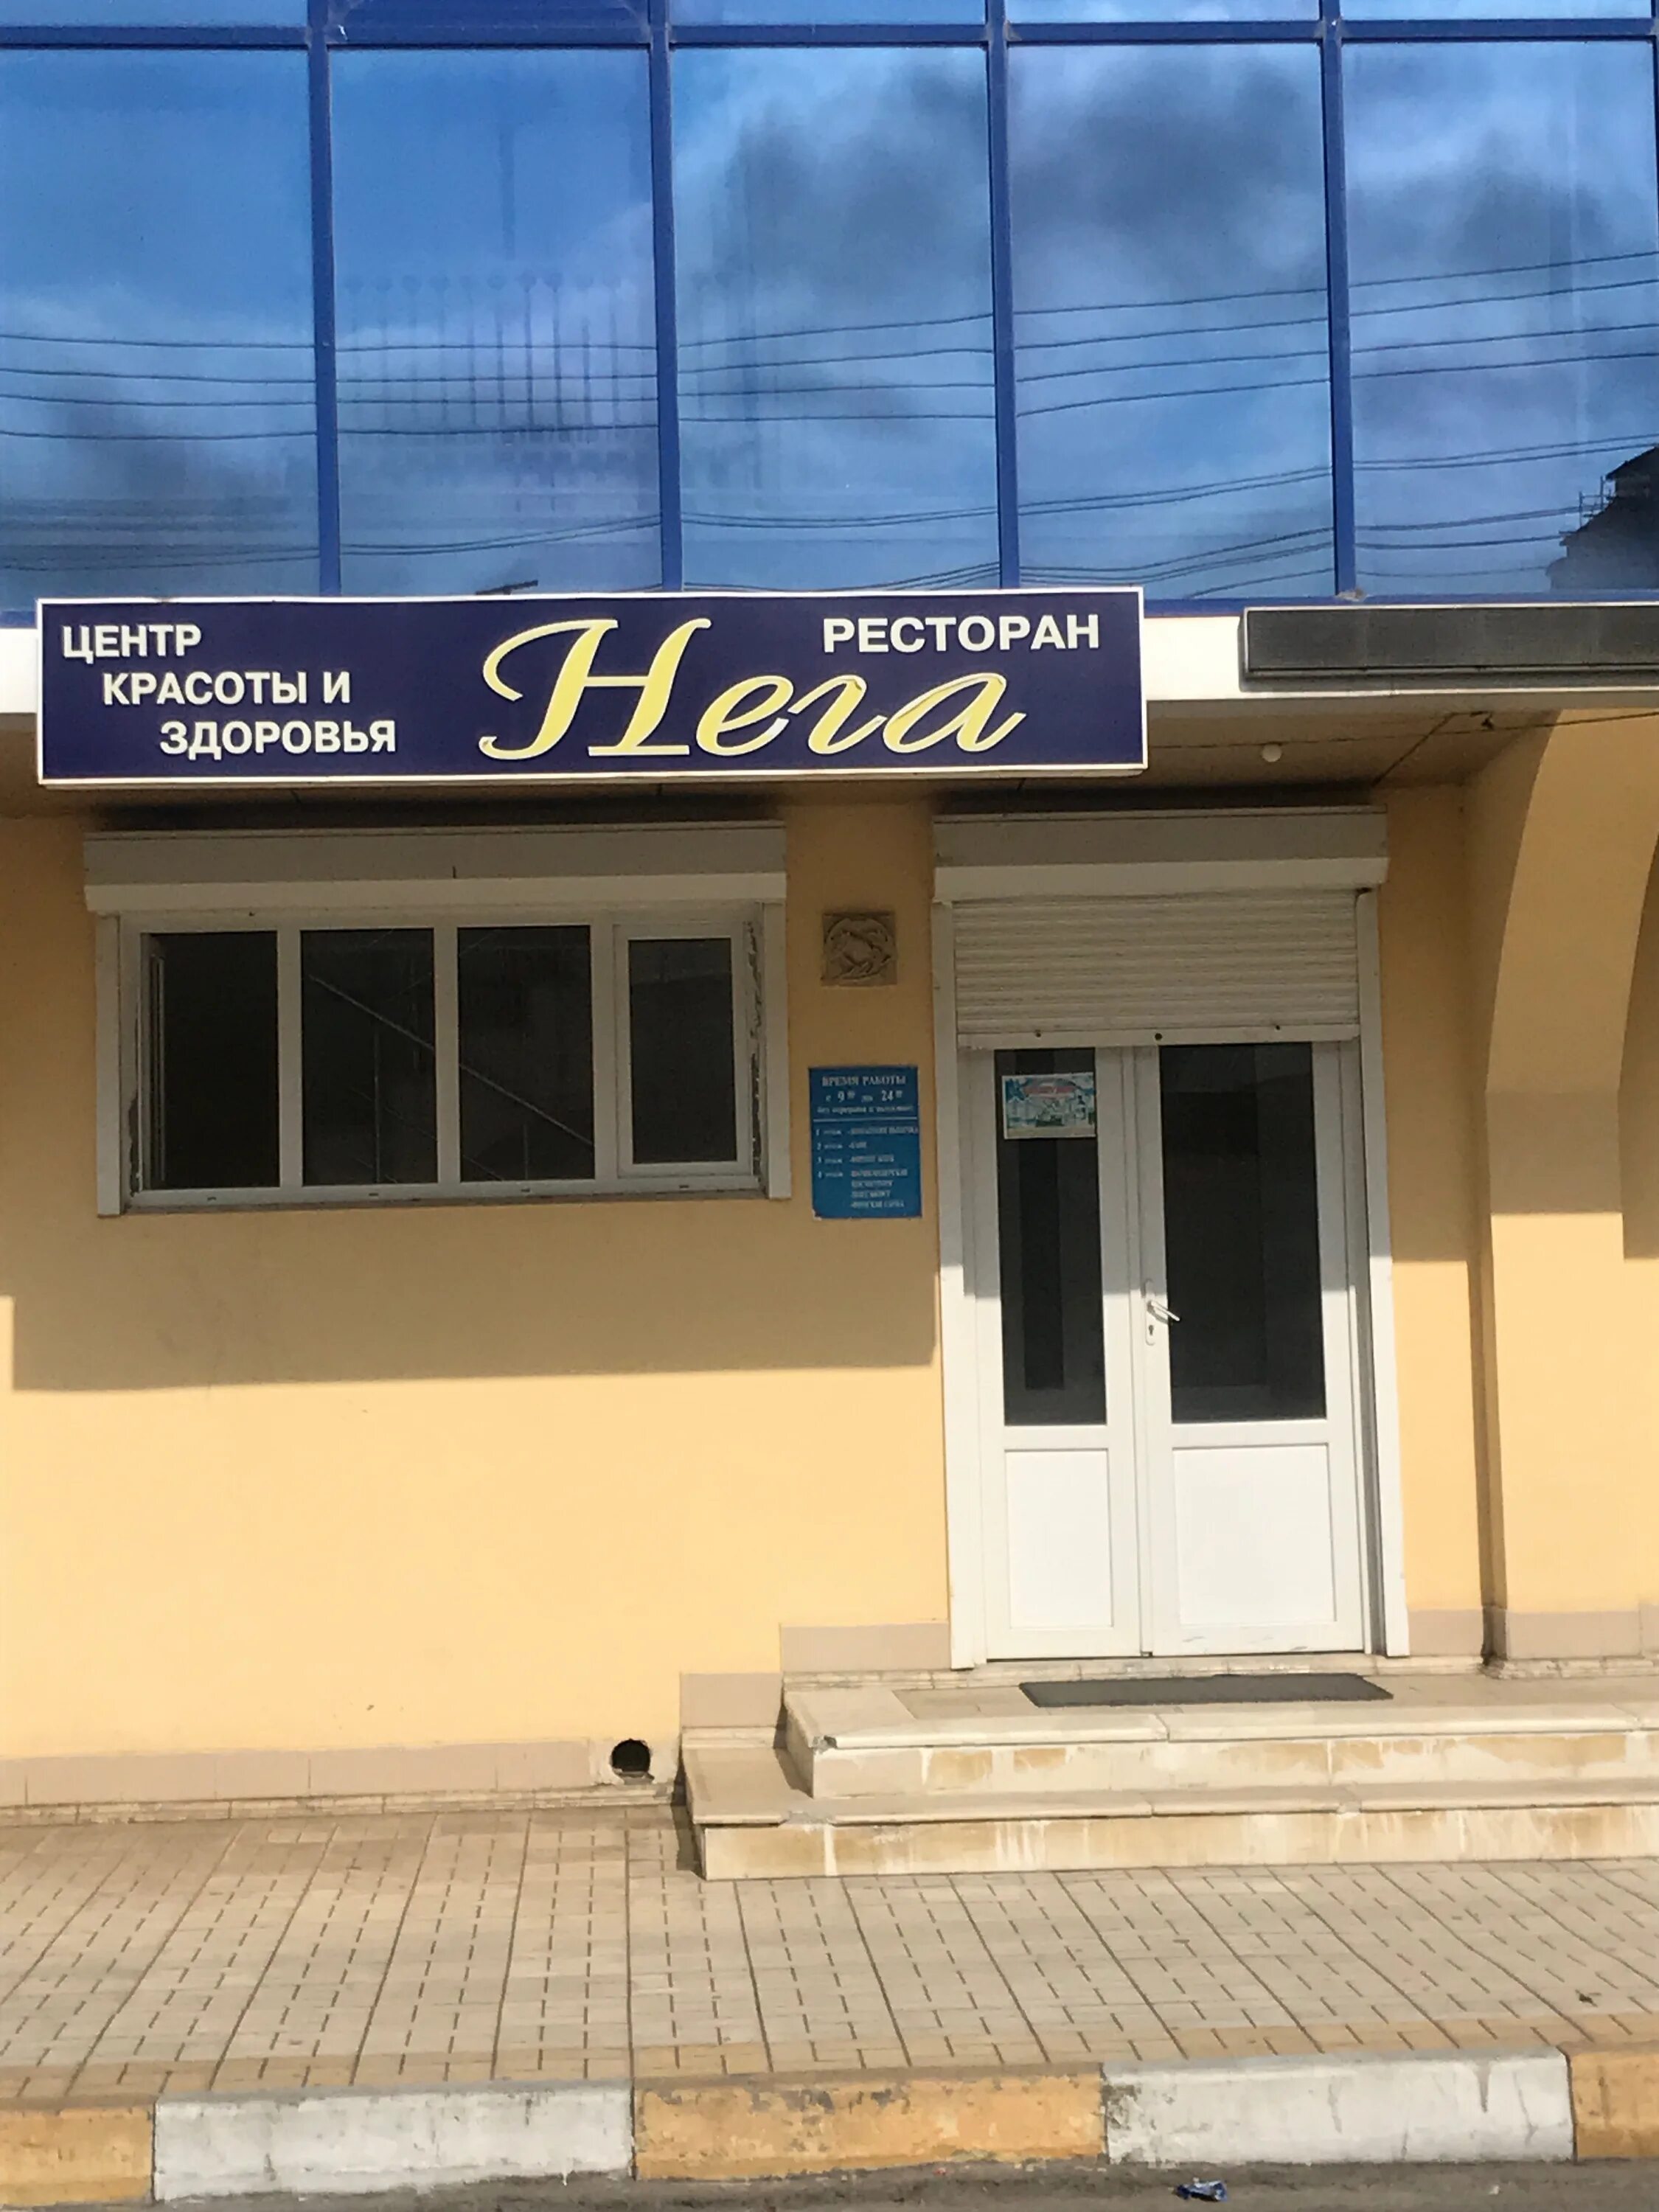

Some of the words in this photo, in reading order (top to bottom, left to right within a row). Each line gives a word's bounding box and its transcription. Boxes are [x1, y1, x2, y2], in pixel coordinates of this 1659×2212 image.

[62, 624, 202, 664] ЦЕНТР
[823, 613, 1099, 653] РЕСТОРАН
[102, 671, 307, 706] КРАСОТЫ
[323, 671, 351, 704] И
[478, 617, 1027, 761] Нега
[160, 720, 396, 761] ЗДОРОВЬЯ
[822, 1076, 859, 1087] ВРЕМЯ
[863, 1075, 906, 1086] РАБОТЫ
